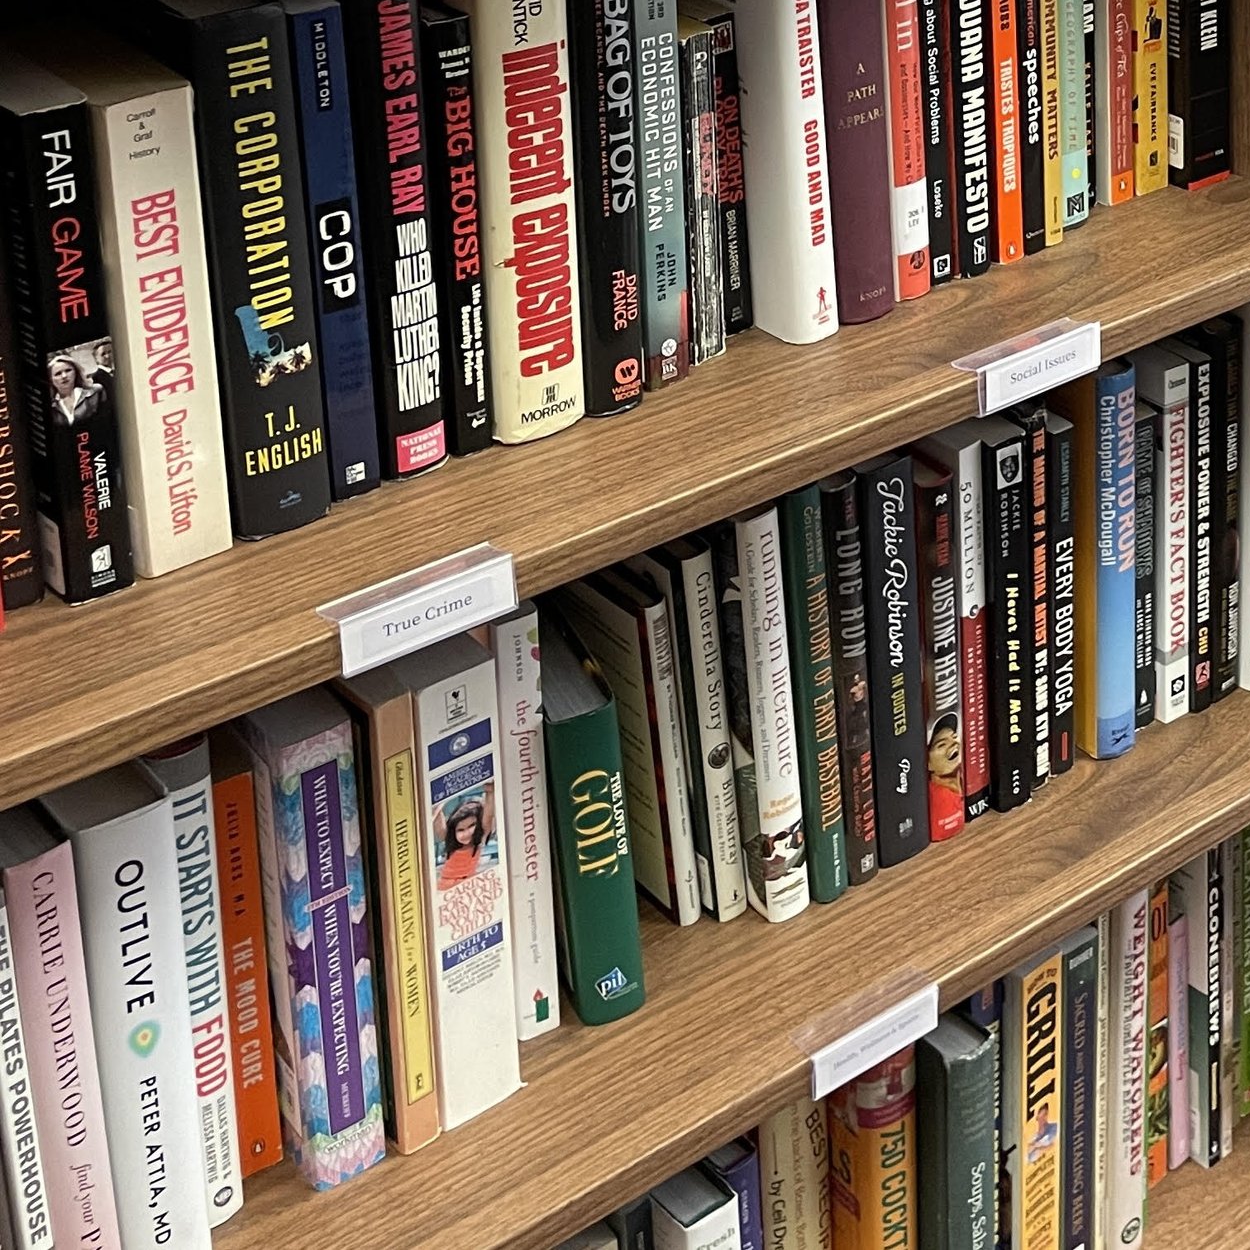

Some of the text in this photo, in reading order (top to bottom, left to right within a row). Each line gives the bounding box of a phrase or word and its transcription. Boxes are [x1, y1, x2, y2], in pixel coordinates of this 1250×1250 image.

[312, 21, 329, 109] MIDDLETON
[607, 70, 631, 119] OF
[795, 14, 815, 98] TRAISTER
[1022, 48, 1039, 145] speeches
[225, 37, 295, 331] THE CORPORATION
[502, 41, 576, 378] indecent exposure
[610, 121, 636, 215] TOYS
[802, 119, 819, 170] GOOD
[805, 170, 823, 204] AND
[962, 86, 989, 234] MANIFESTO
[41, 130, 88, 325] FAIR GAME
[317, 211, 356, 299] COP
[809, 205, 824, 247] MAD
[130, 189, 193, 405] BEST EVIDENCE
[520, 395, 576, 425] MORROW
[1009, 350, 1077, 385] Social Issues
[1117, 385, 1136, 572] BORN TO RUN
[1171, 403, 1190, 532] FIGHTER'S
[382, 595, 473, 637] True Crime
[877, 477, 908, 667] Jackie Robinson
[1055, 536, 1074, 717] EVERY BODY YOGA
[695, 572, 723, 731] Cinderella Story
[570, 770, 619, 877] GOLF
[114, 860, 156, 1014] OUTLIVE
[172, 789, 227, 1098] IT STARTS WITH FOOD
[1208, 887, 1220, 1047] CLONEBREWS
[30, 870, 88, 1148] CARRIE UNDERWOOD
[7, 1077, 48, 1245] POWERHOUSE
